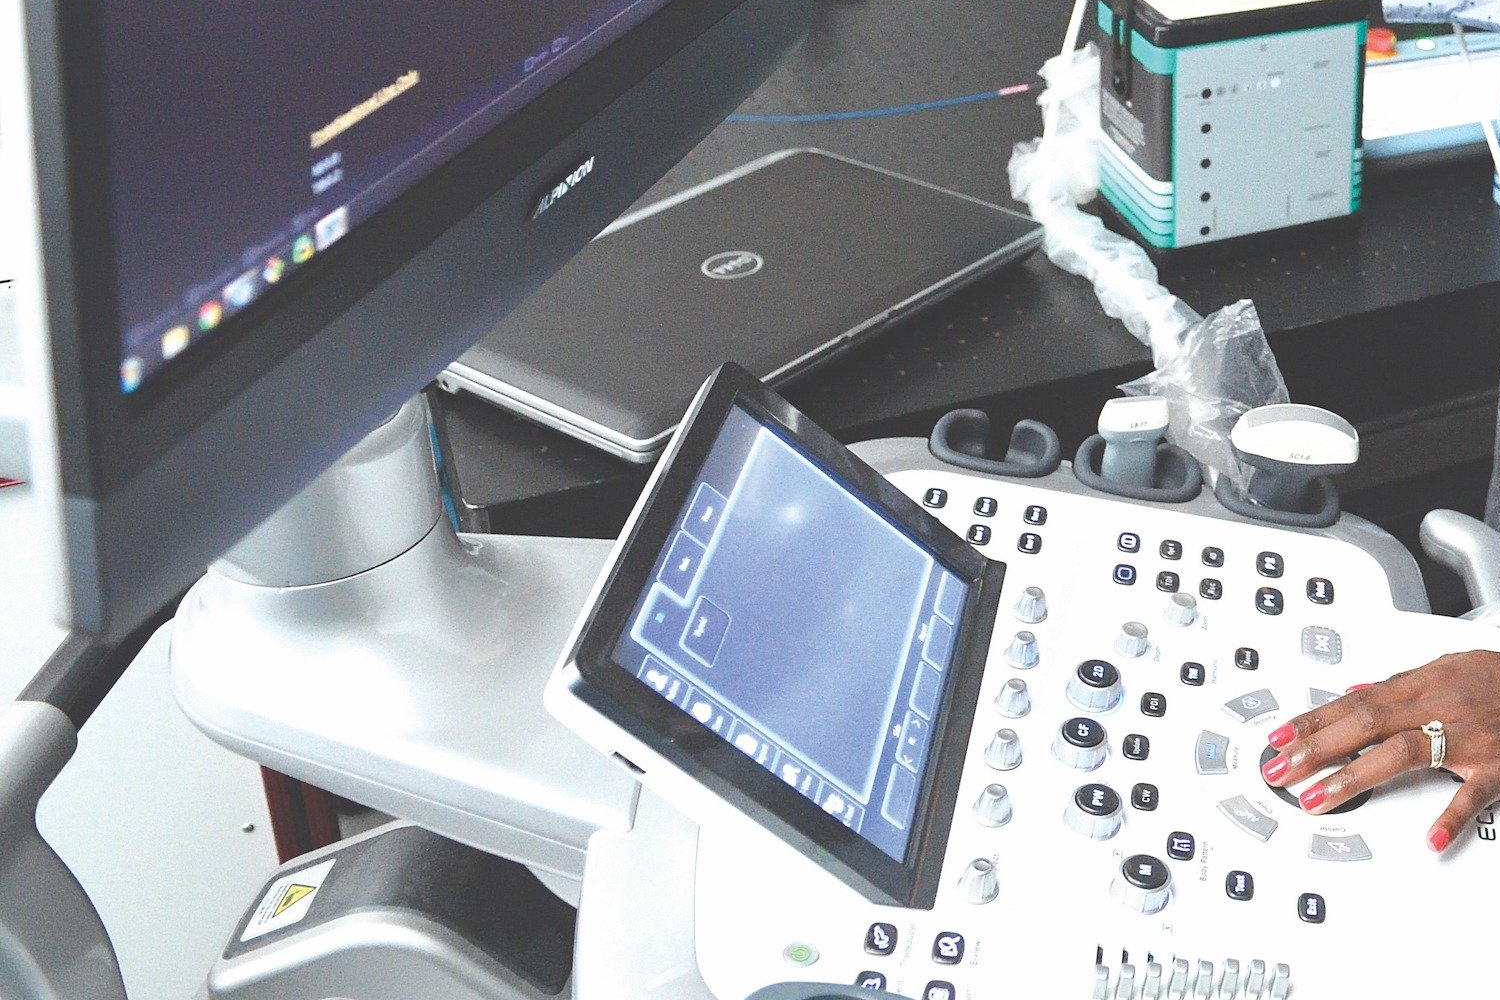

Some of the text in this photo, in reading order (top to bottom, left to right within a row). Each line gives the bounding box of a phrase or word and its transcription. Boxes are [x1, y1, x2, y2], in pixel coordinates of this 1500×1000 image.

[533, 156, 595, 219] ALPINION
[1264, 556, 1276, 570] P2
[1092, 665, 1105, 678] 2D
[1150, 697, 1159, 710] PDI
[1077, 723, 1090, 737] CF
[1132, 737, 1141, 755] Update
[1092, 789, 1105, 807] PW
[1141, 789, 1151, 803] CW
[1199, 841, 1208, 882] Body Pattern
[1139, 864, 1152, 876] M
[1235, 874, 1246, 893] Text
[1306, 897, 1317, 915] Exit
